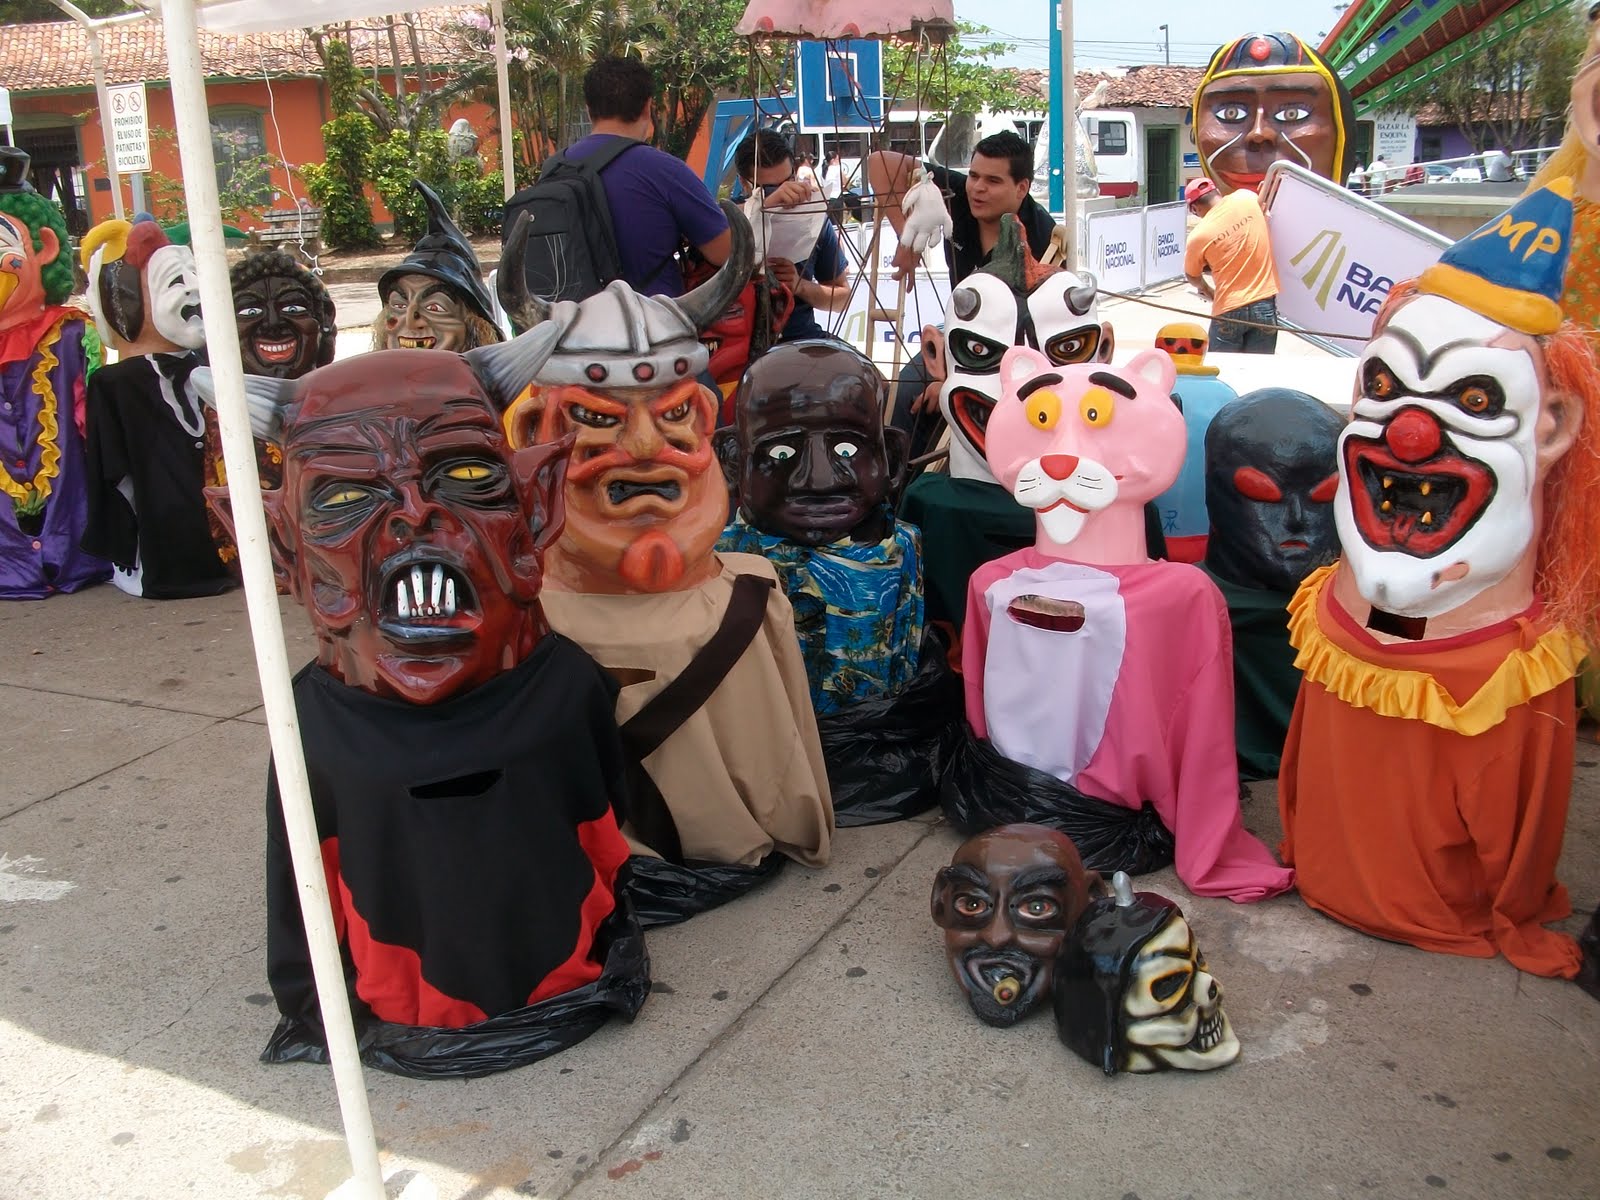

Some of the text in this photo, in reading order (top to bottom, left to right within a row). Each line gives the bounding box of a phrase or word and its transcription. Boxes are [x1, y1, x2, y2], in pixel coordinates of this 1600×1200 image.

[114, 115, 143, 127] PROHIBIDO
[118, 129, 141, 140] EL USO DE
[1380, 131, 1407, 139] ESQUINA
[116, 142, 142, 153] PATINETAS
[118, 155, 145, 166] BICICLETAS
[1158, 232, 1174, 246] BANCO
[1471, 214, 1562, 263] MP
[1105, 241, 1127, 256] BANCO
[1157, 243, 1180, 258] NACIONAL
[1105, 253, 1135, 269] NACIONAL
